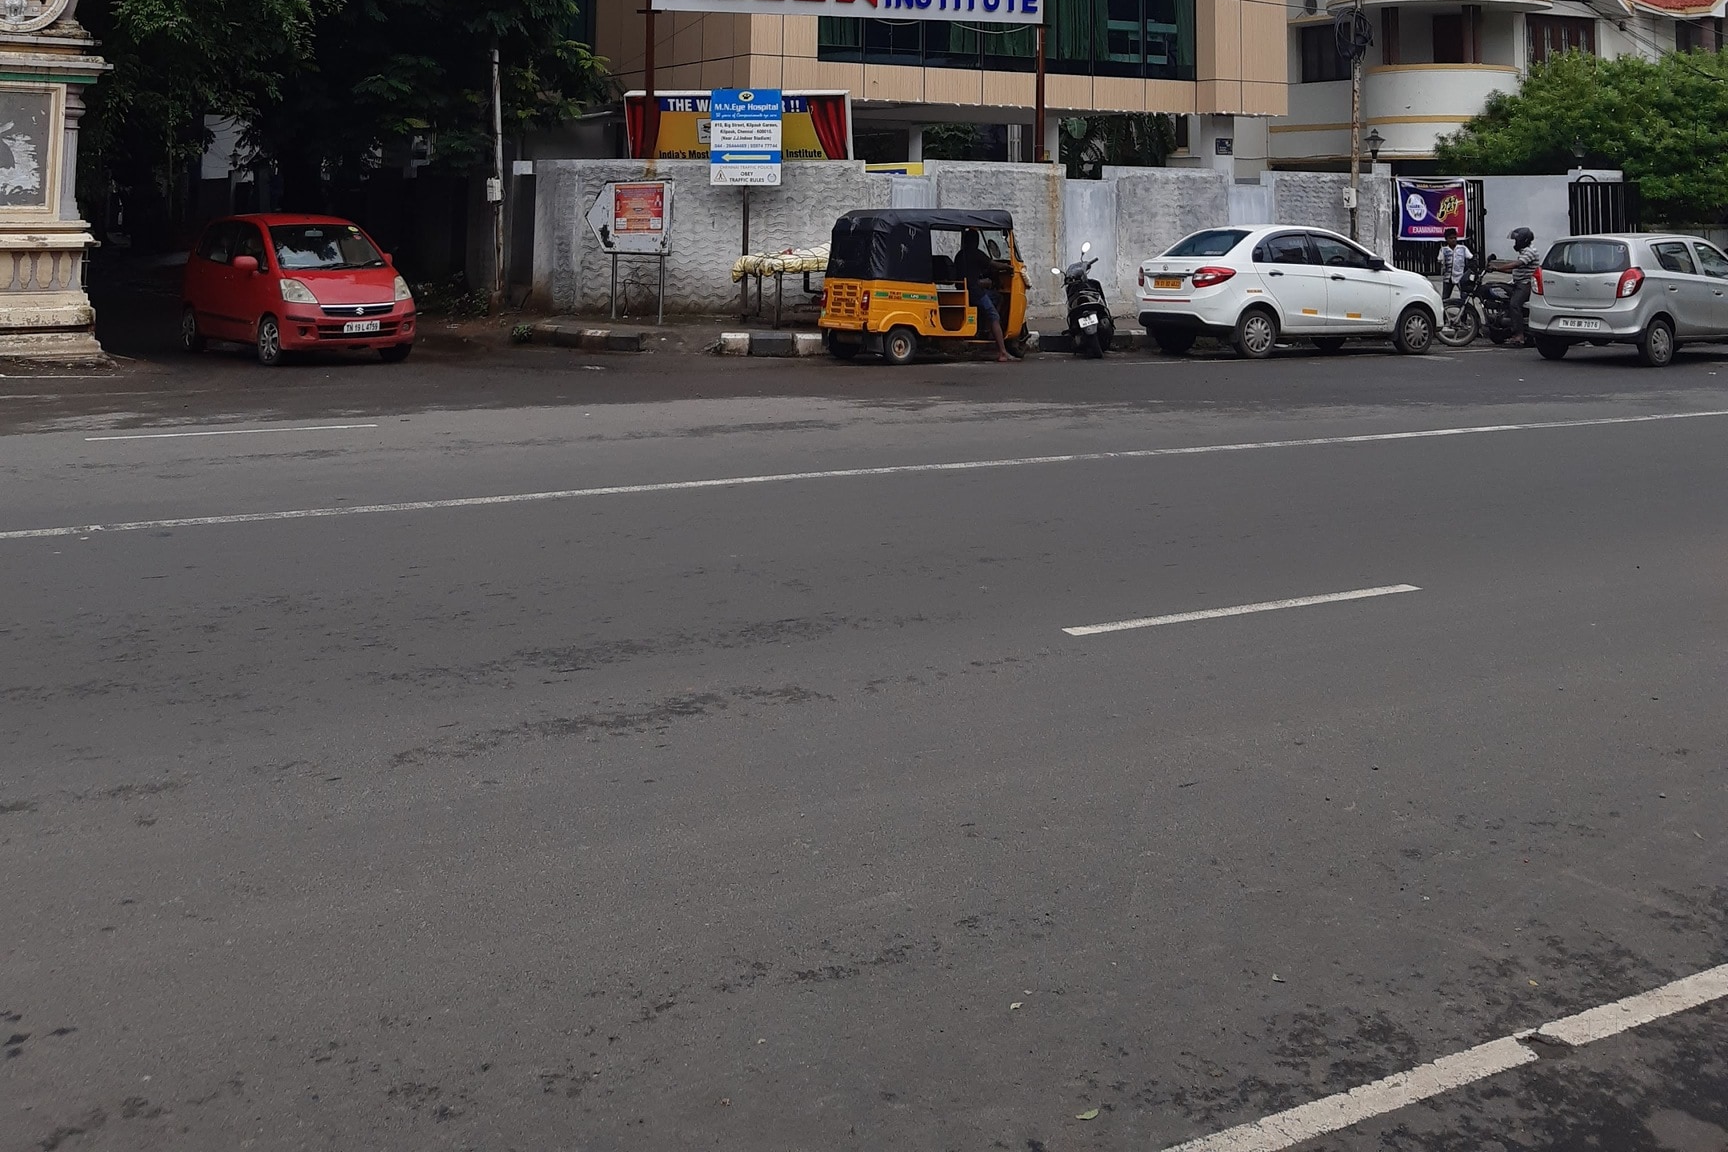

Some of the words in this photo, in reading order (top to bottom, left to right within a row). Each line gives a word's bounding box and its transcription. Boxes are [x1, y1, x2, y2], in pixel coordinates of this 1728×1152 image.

[667, 98, 692, 112] THE
[714, 103, 746, 113] M.N.Eye
[747, 103, 779, 112] Hospital
[658, 150, 687, 160] India's
[688, 150, 711, 160] Most
[786, 149, 822, 159] Institute
[1412, 226, 1443, 234] EXAMINATION
[347, 323, 354, 332] TN
